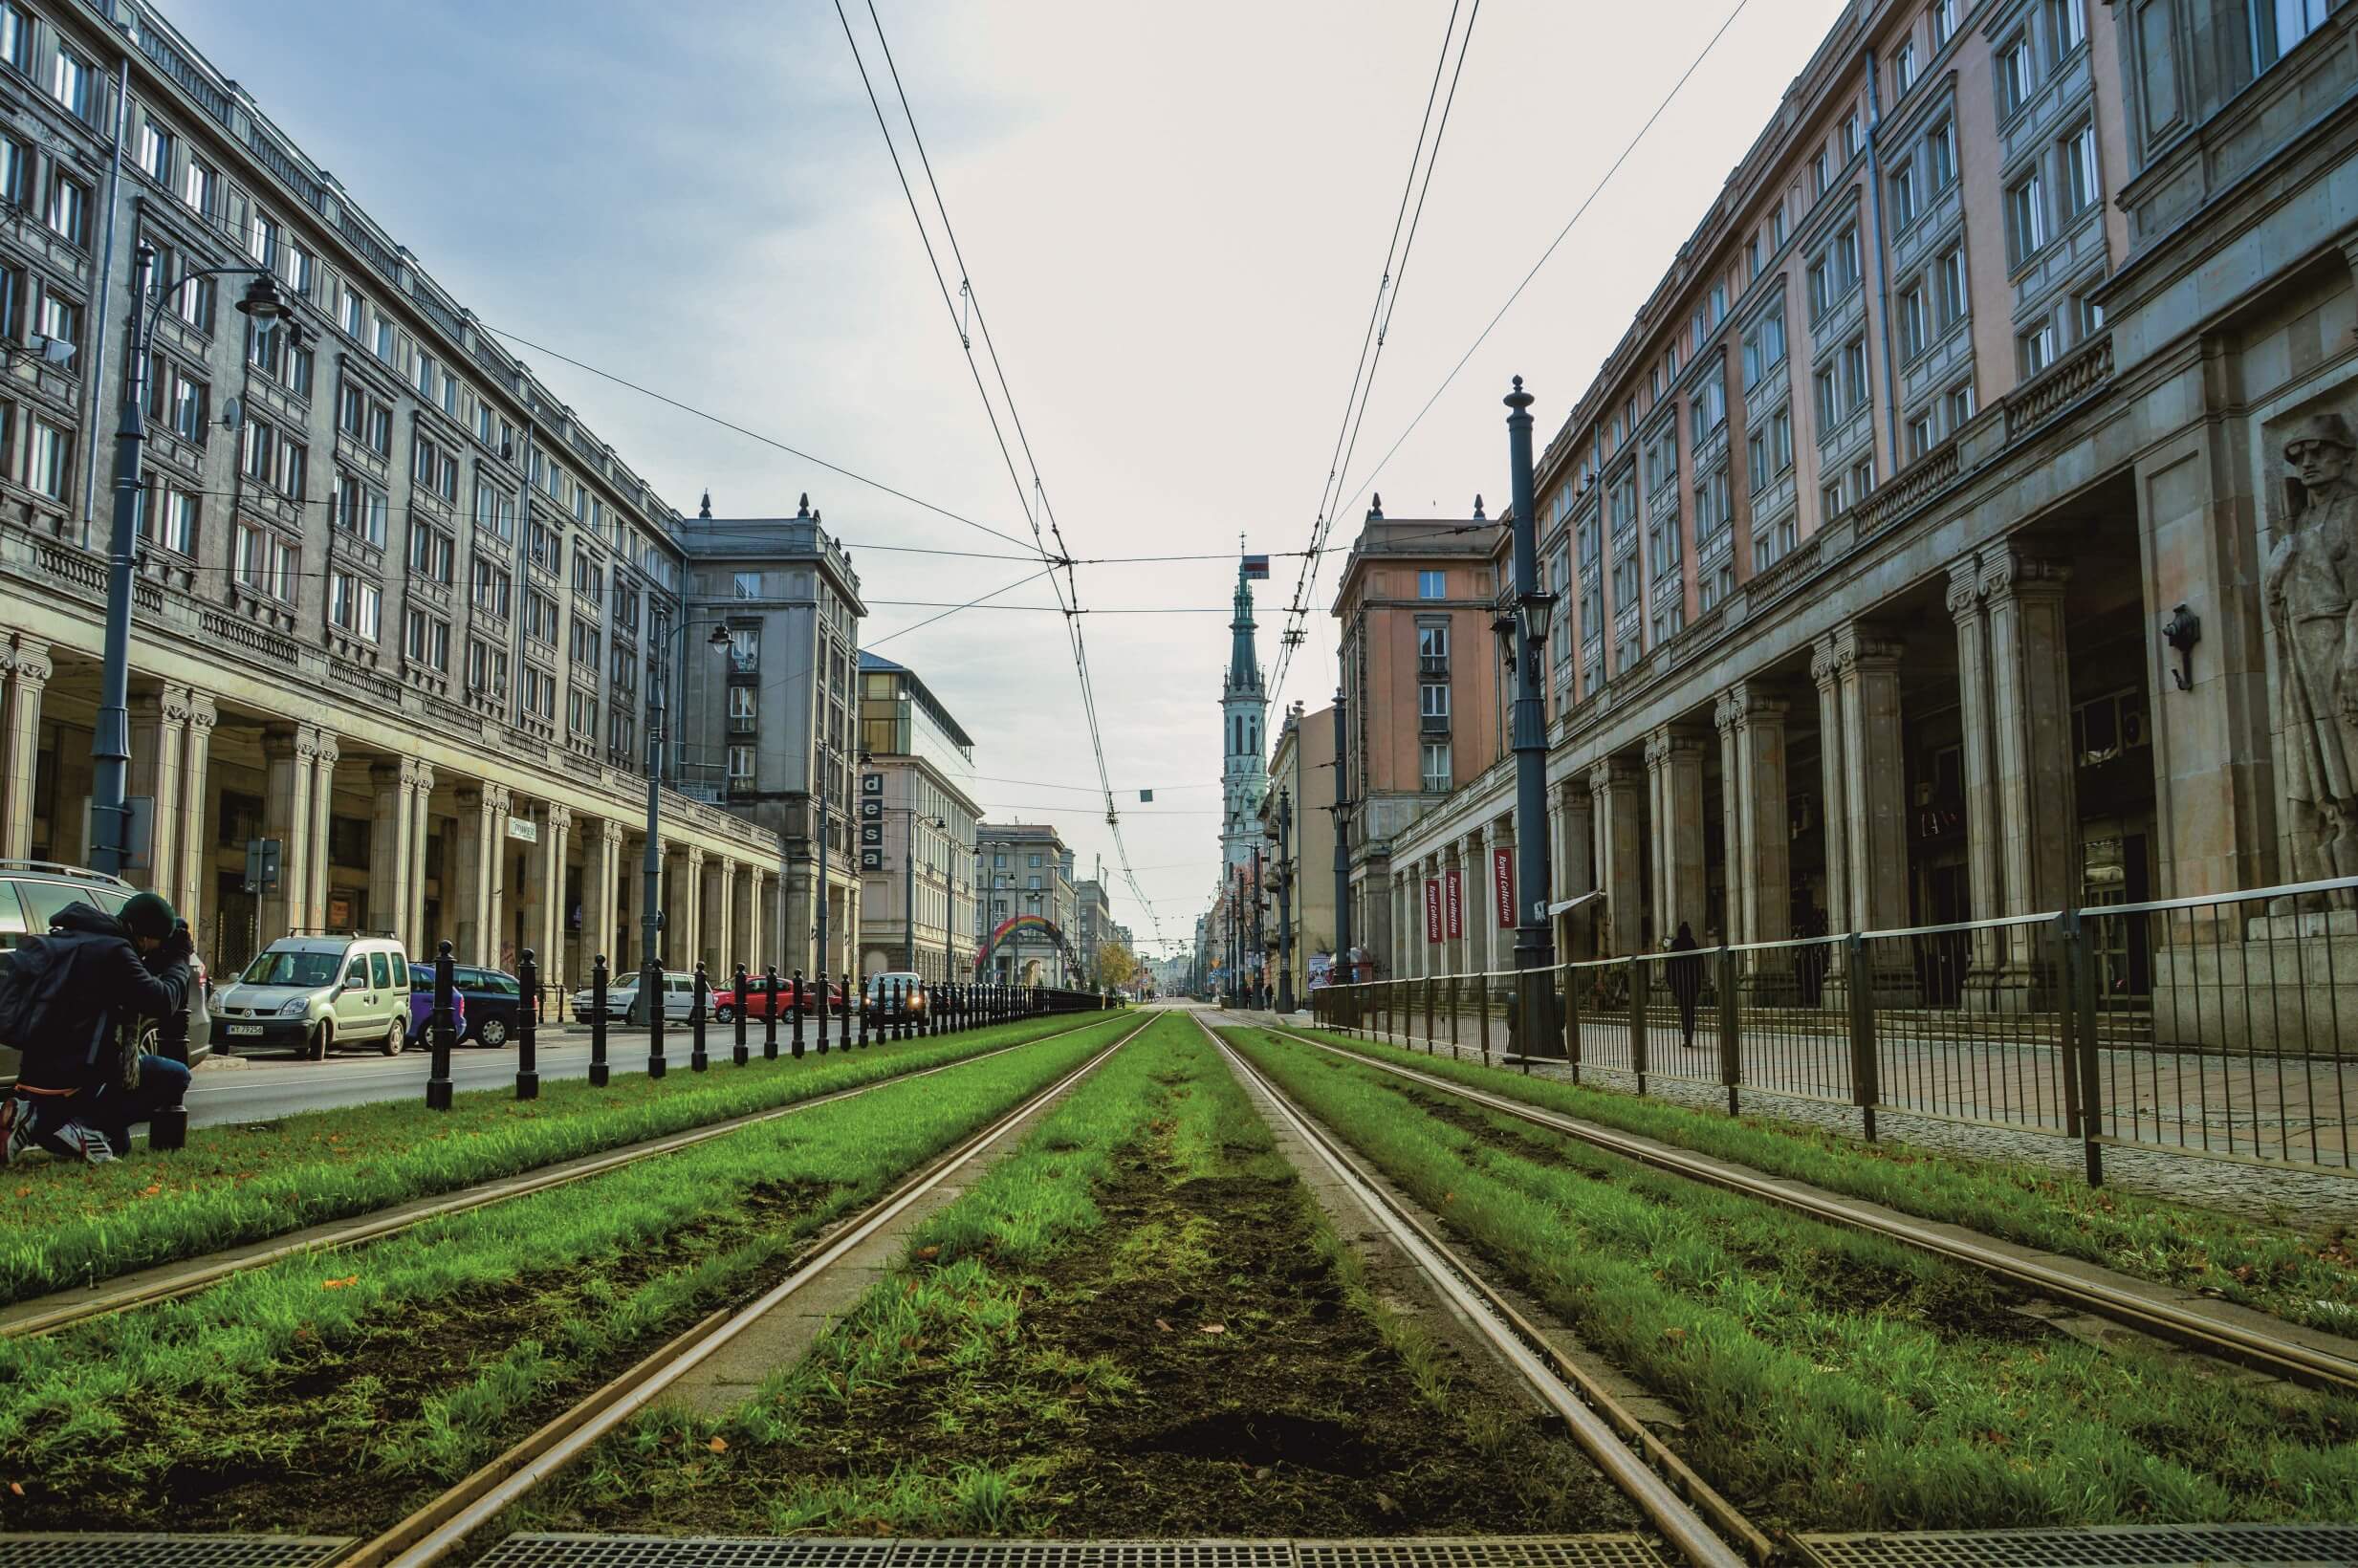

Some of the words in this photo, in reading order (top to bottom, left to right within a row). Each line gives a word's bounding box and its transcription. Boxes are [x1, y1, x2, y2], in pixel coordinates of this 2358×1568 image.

[864, 775, 879, 865] desa
[1498, 856, 1508, 880] Royal
[1449, 876, 1457, 898] Royal
[1500, 881, 1511, 923] Collection
[1450, 899, 1458, 934] Collection
